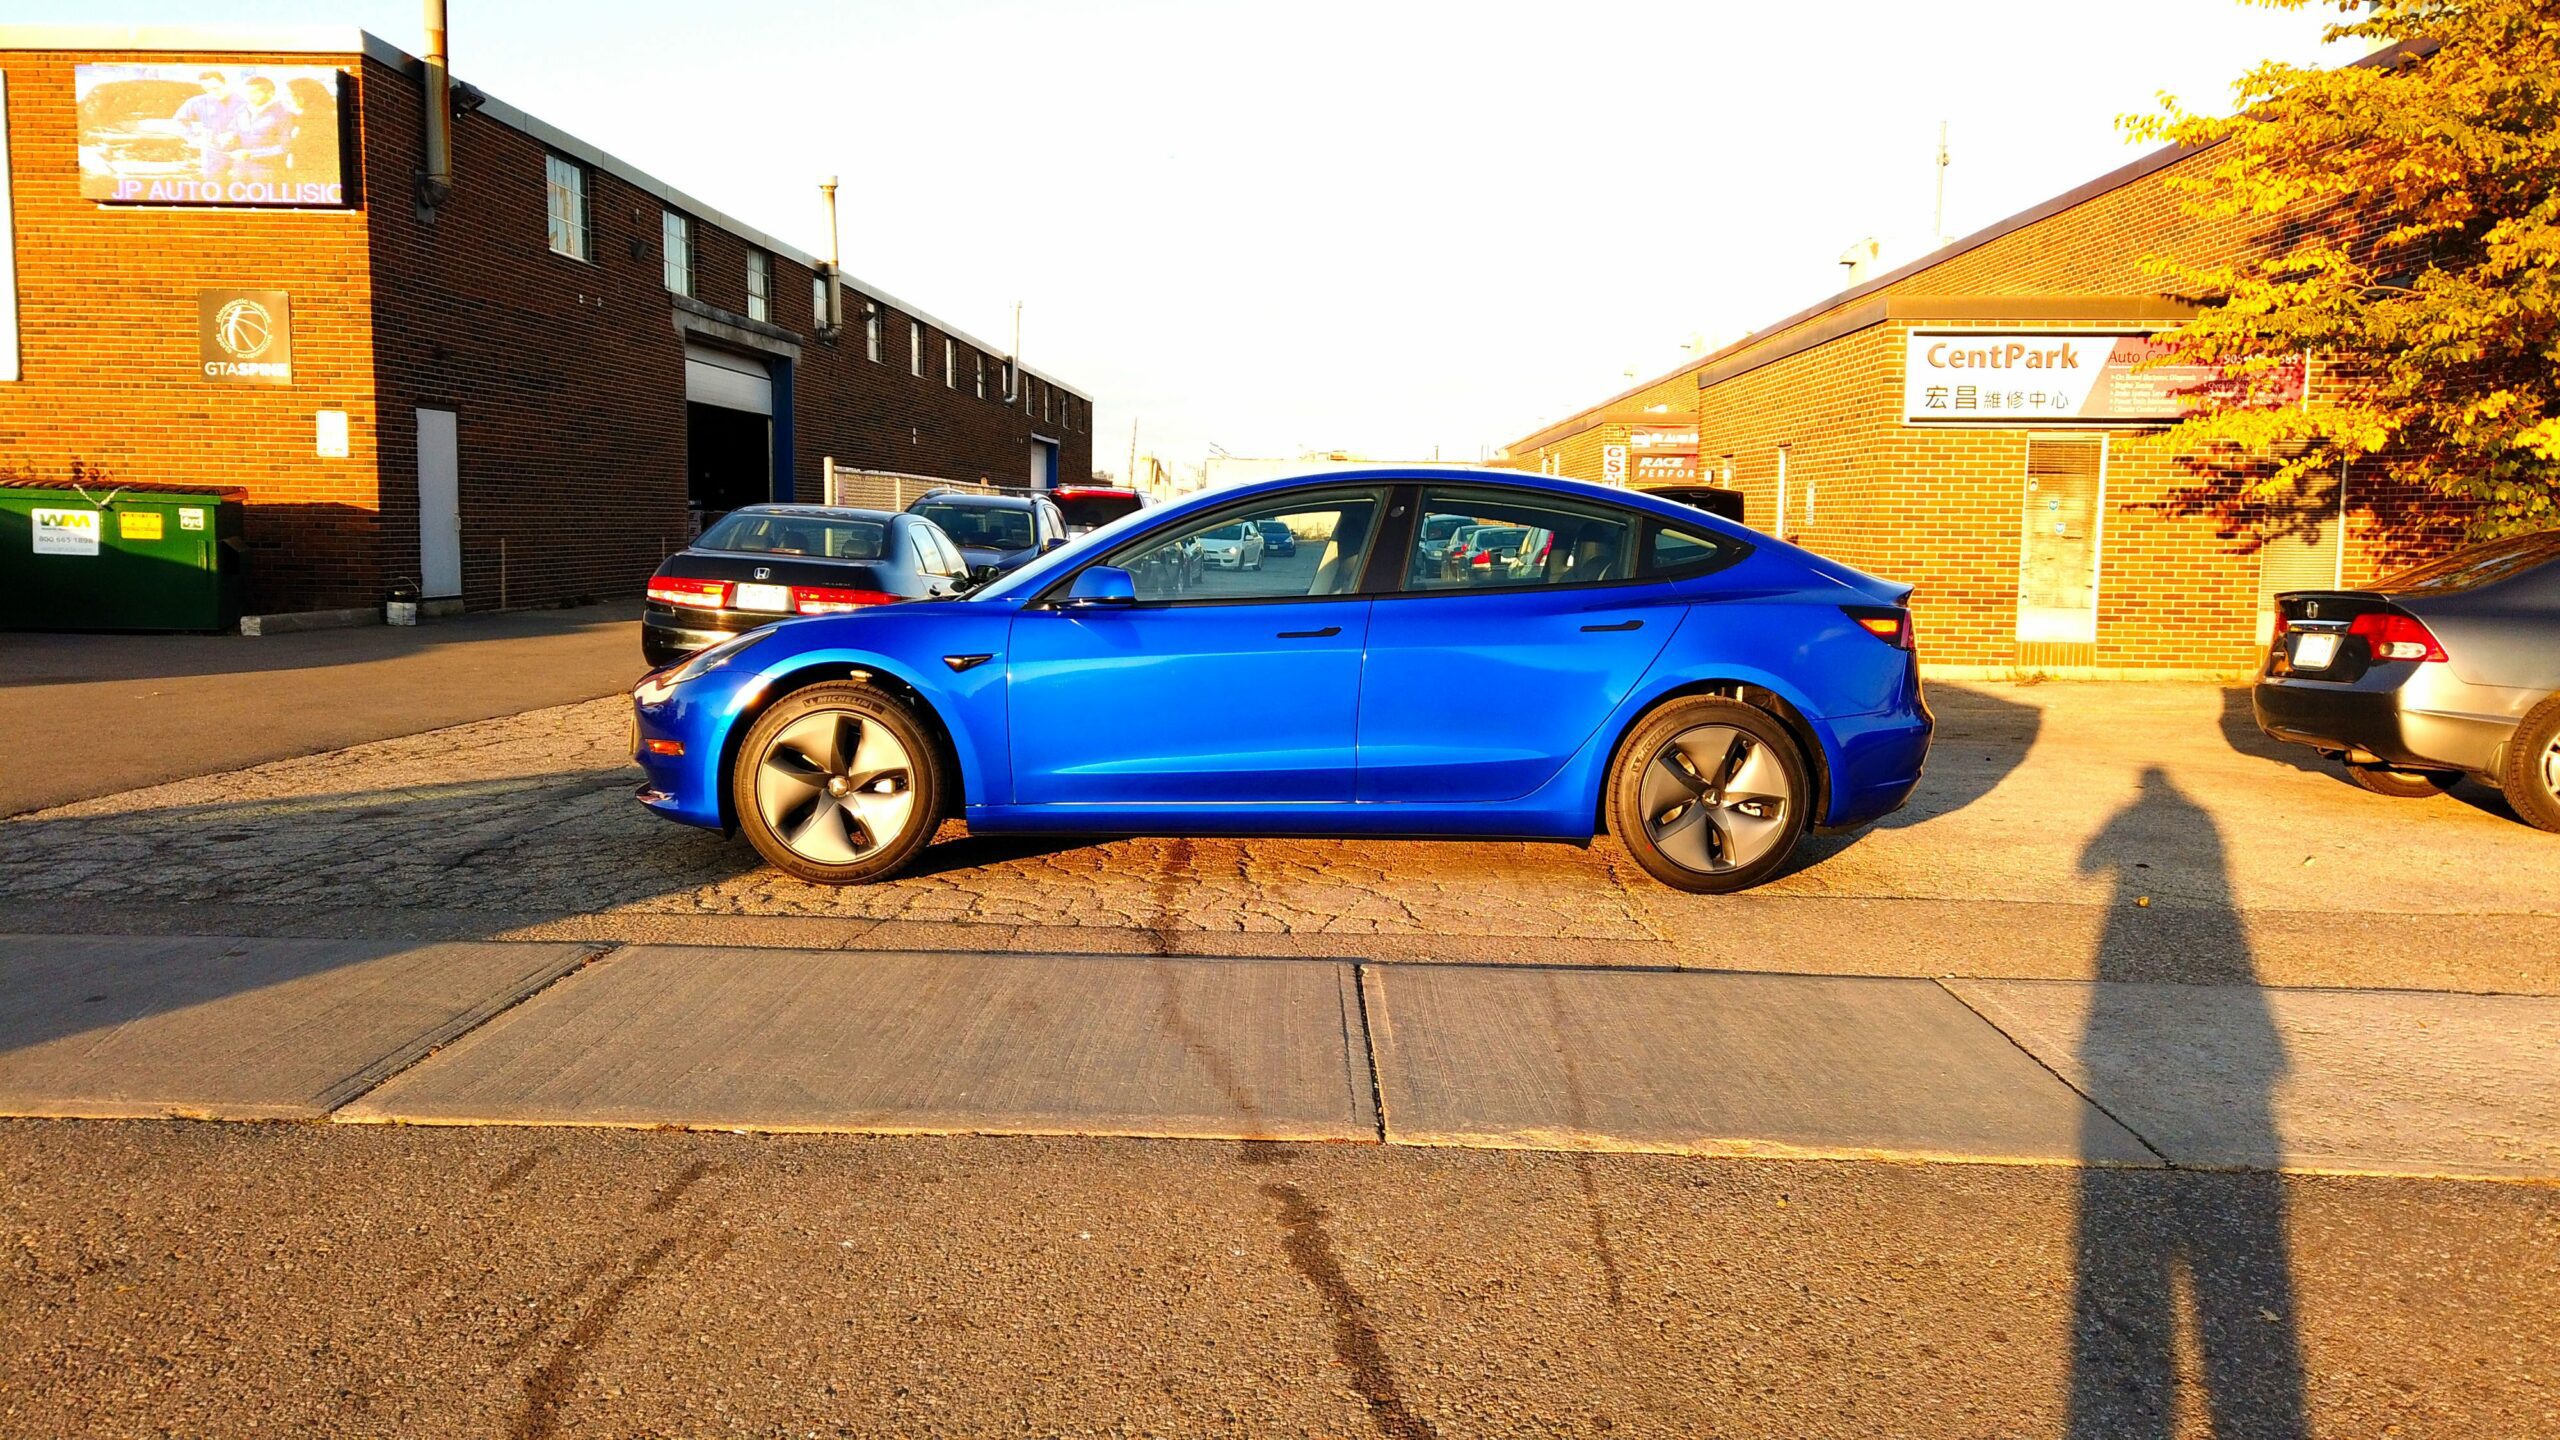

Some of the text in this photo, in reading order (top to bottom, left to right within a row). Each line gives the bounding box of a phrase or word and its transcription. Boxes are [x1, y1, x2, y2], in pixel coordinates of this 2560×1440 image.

[111, 179, 142, 200] JP
[148, 180, 221, 201] AUTO
[1927, 342, 2080, 369] CentPark
[2108, 350, 2141, 363] Auto
[1925, 385, 2069, 410] 宏昌維修中心
[1638, 457, 1686, 468] RACE
[40, 513, 91, 528] WM
[816, 695, 871, 708] MICHELIN
